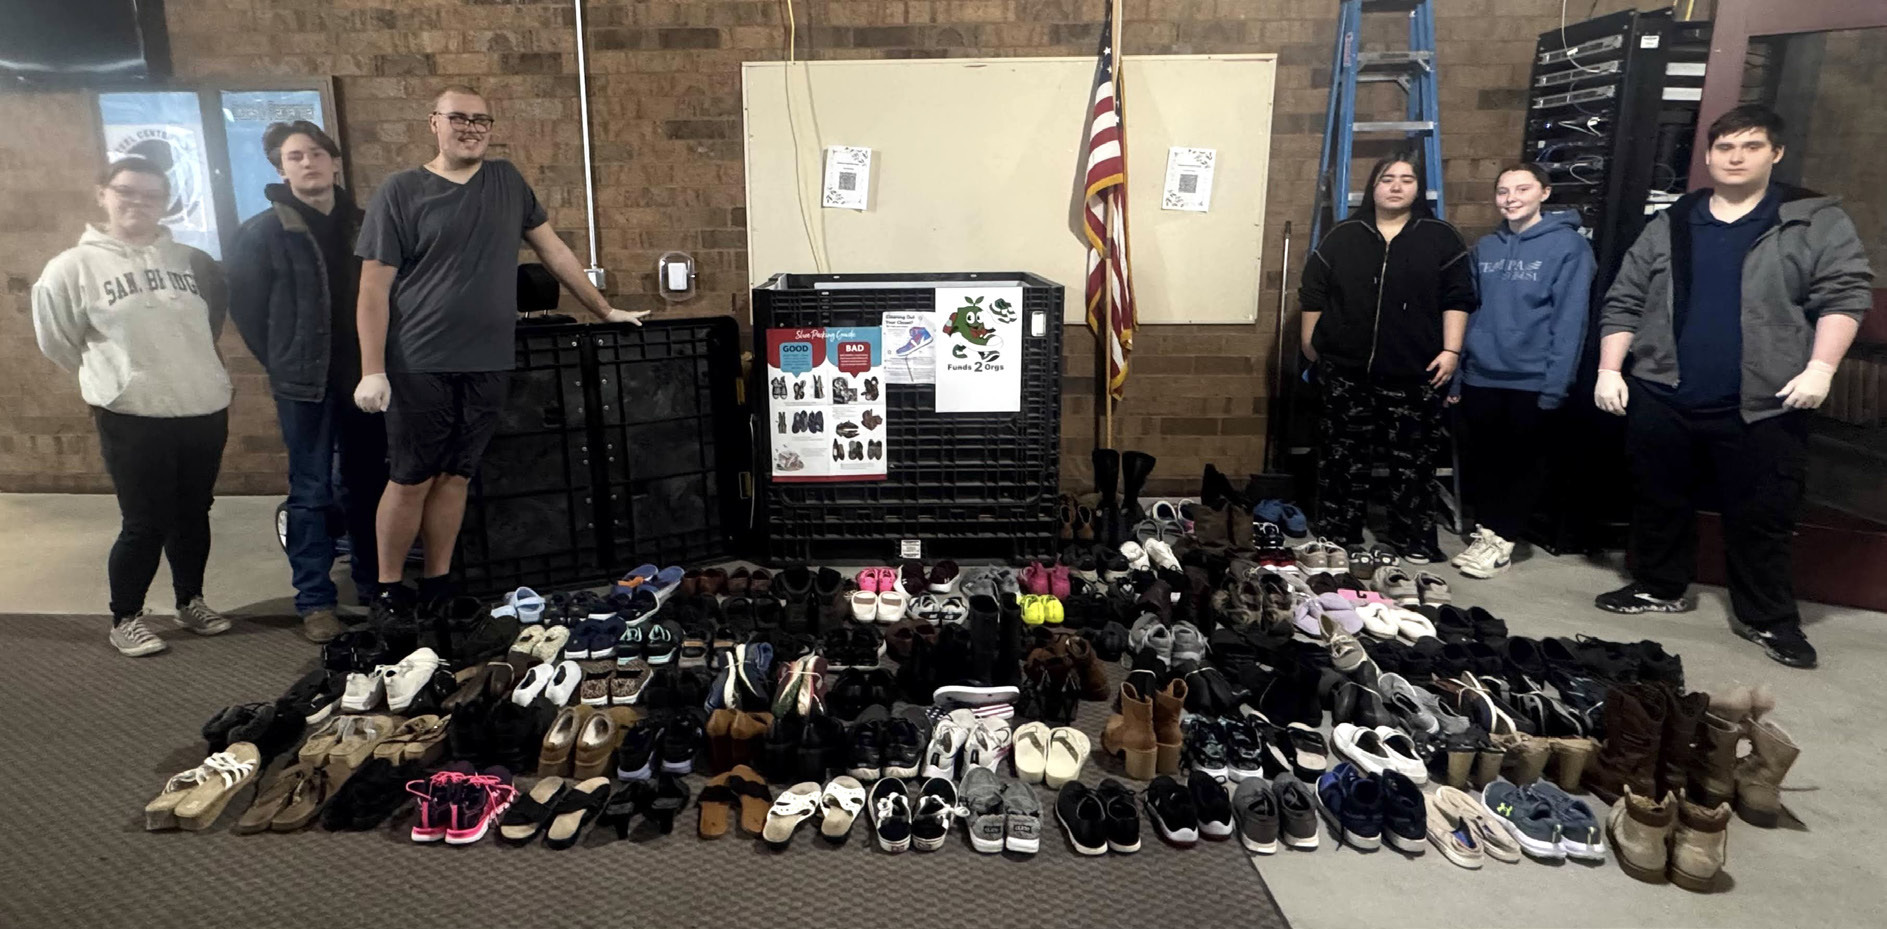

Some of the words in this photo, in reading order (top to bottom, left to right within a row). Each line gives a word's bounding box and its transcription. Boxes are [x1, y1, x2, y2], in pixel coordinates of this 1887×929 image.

[782, 345, 809, 353] GOOD
[845, 344, 865, 352] BAD
[947, 363, 972, 371] Funds
[974, 361, 983, 372] 2
[984, 363, 1004, 372] Orgs
